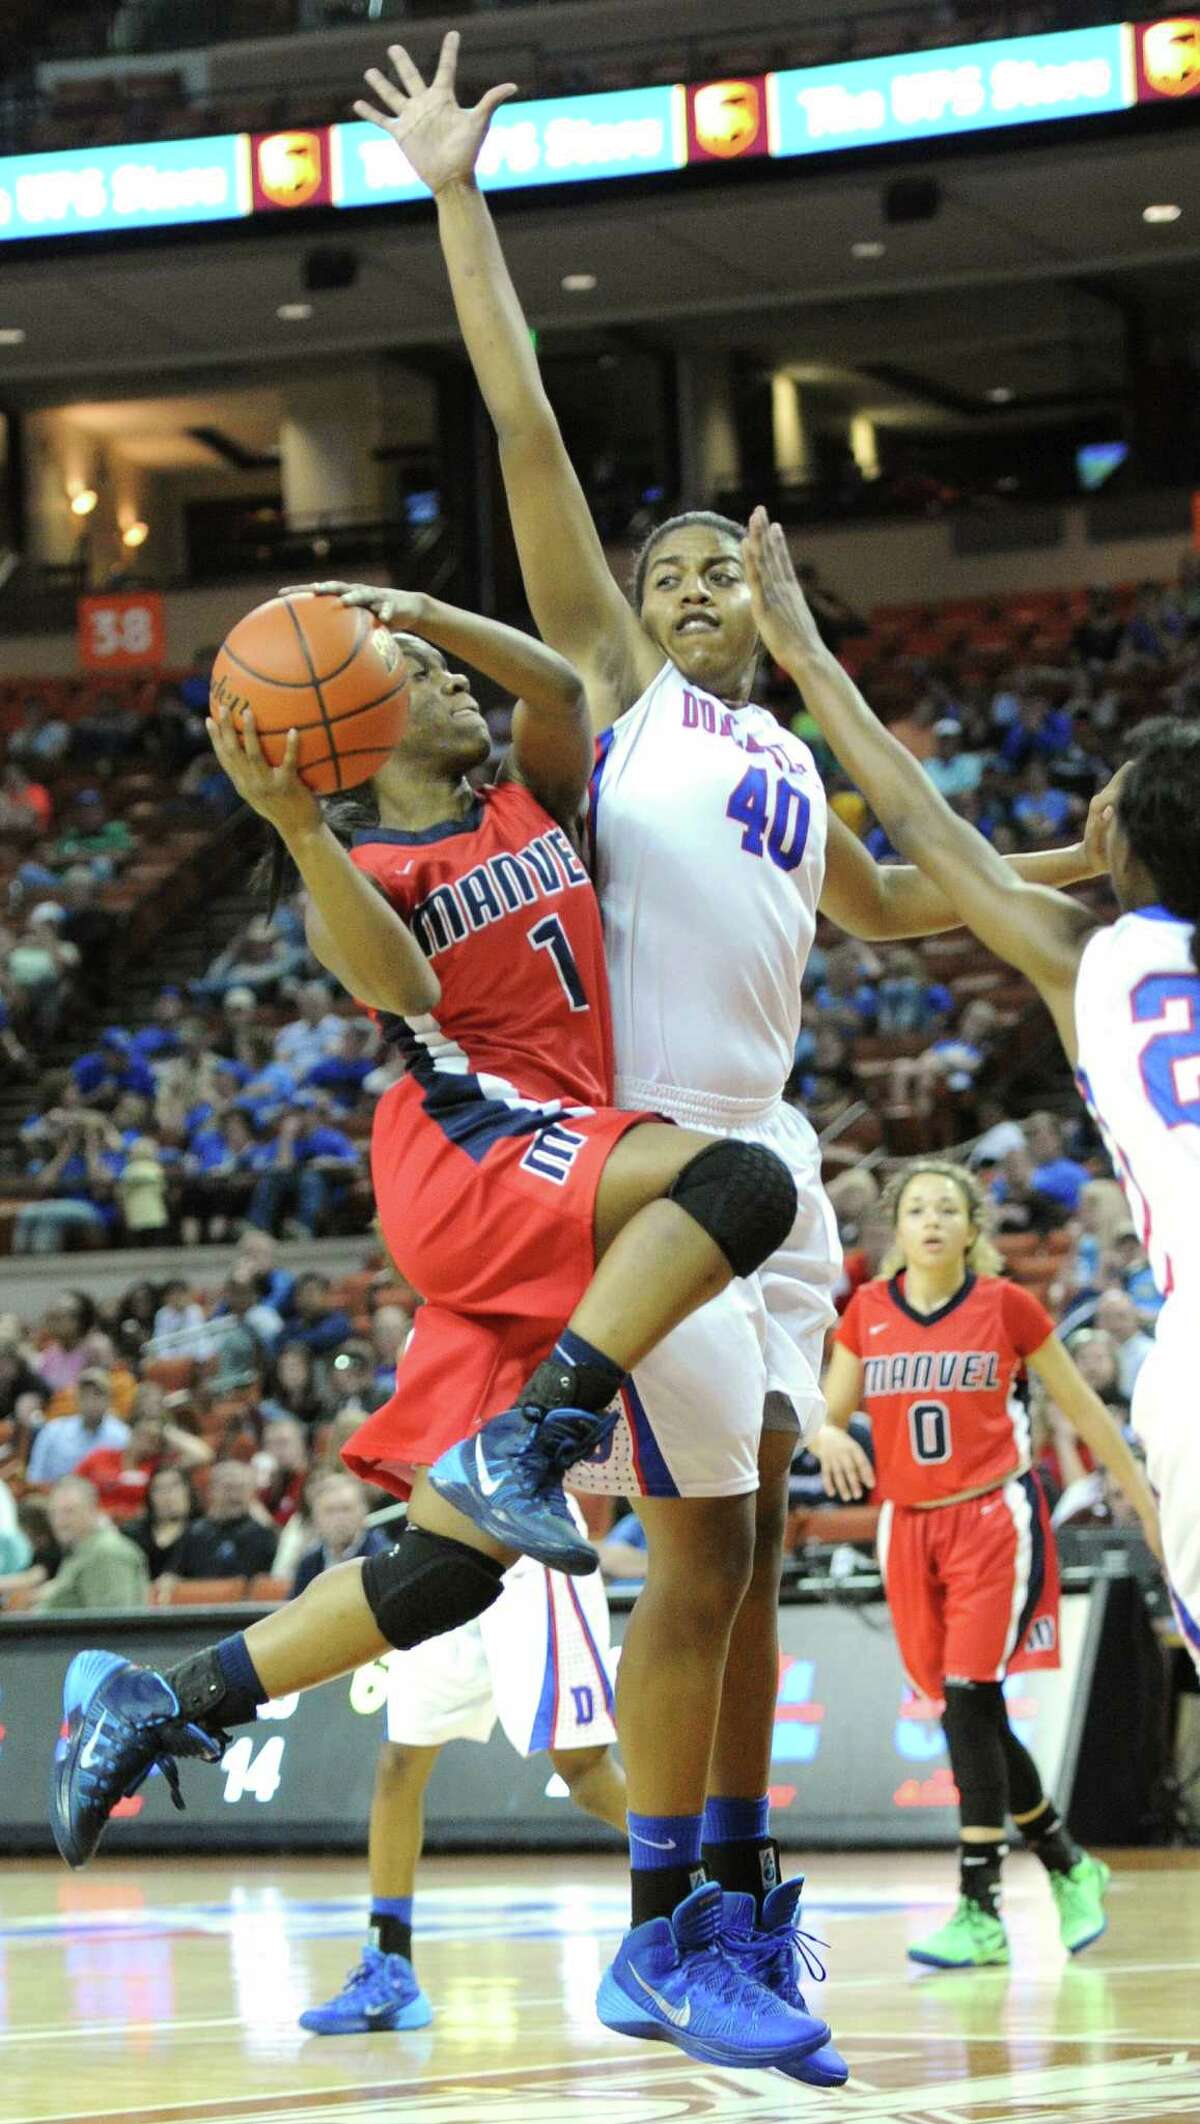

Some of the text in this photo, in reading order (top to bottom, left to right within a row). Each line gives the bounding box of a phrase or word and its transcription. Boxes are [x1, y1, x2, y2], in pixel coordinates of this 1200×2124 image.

[726, 764, 811, 872] 40
[410, 827, 592, 960] MANVE
[527, 913, 590, 1013] 1
[863, 1351, 1000, 1398] MANVEL
[908, 1400, 953, 1466] 0
[570, 1685, 593, 1725] D
[221, 1736, 286, 1803] 14
